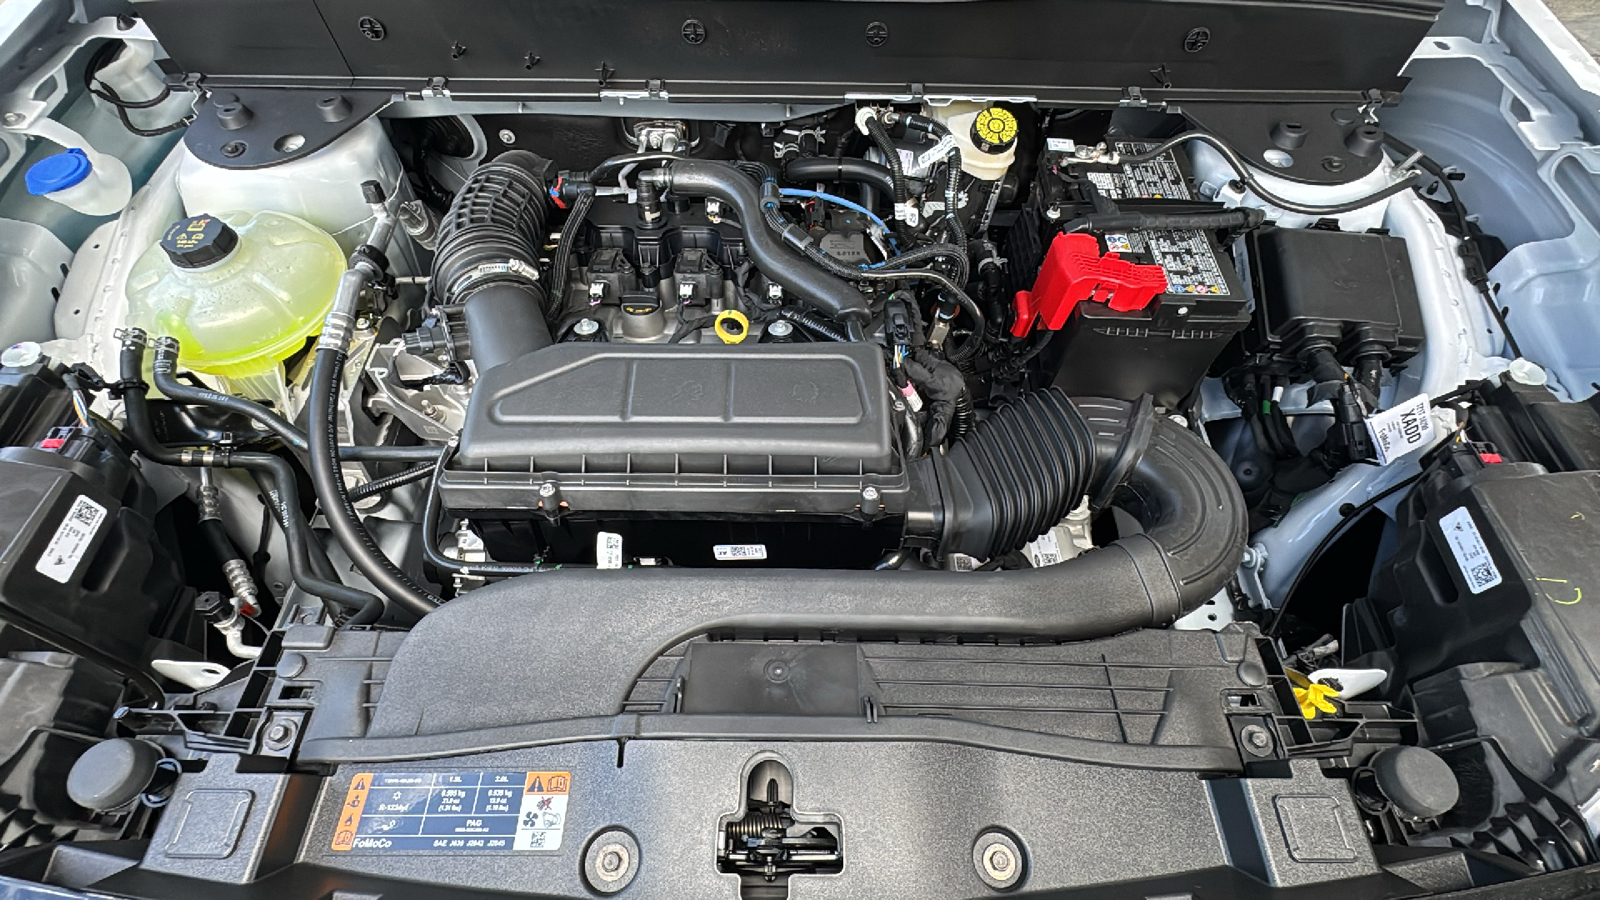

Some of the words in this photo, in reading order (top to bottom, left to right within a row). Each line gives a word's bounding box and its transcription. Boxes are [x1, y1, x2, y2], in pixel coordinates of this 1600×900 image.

[1400, 408, 1422, 444] XADD
[466, 819, 482, 827] PAG
[352, 838, 392, 848] FoMoCo
[433, 839, 447, 847] SAE
